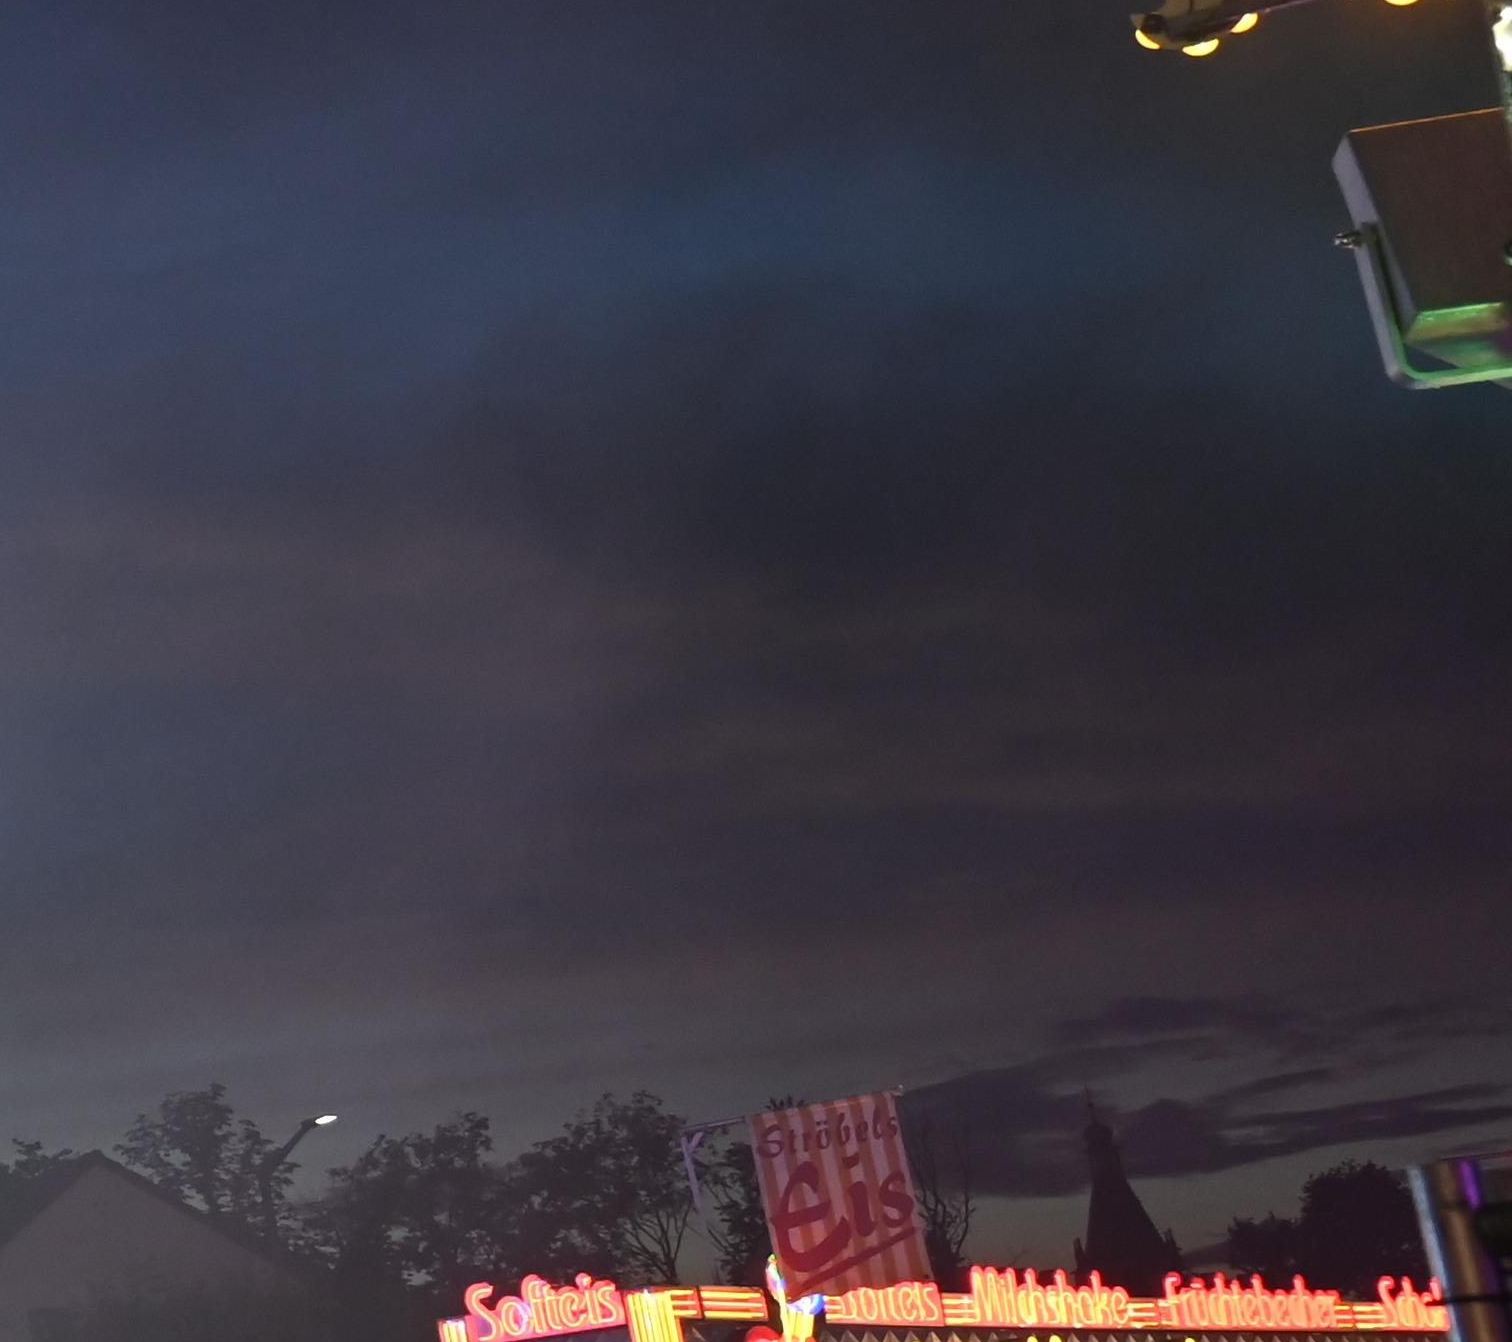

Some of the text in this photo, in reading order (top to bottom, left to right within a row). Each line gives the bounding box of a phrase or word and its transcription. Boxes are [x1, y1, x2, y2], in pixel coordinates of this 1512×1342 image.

[758, 1108, 899, 1158] Ströbels
[770, 1153, 914, 1273] Eis
[464, 1272, 621, 1342] Softeis
